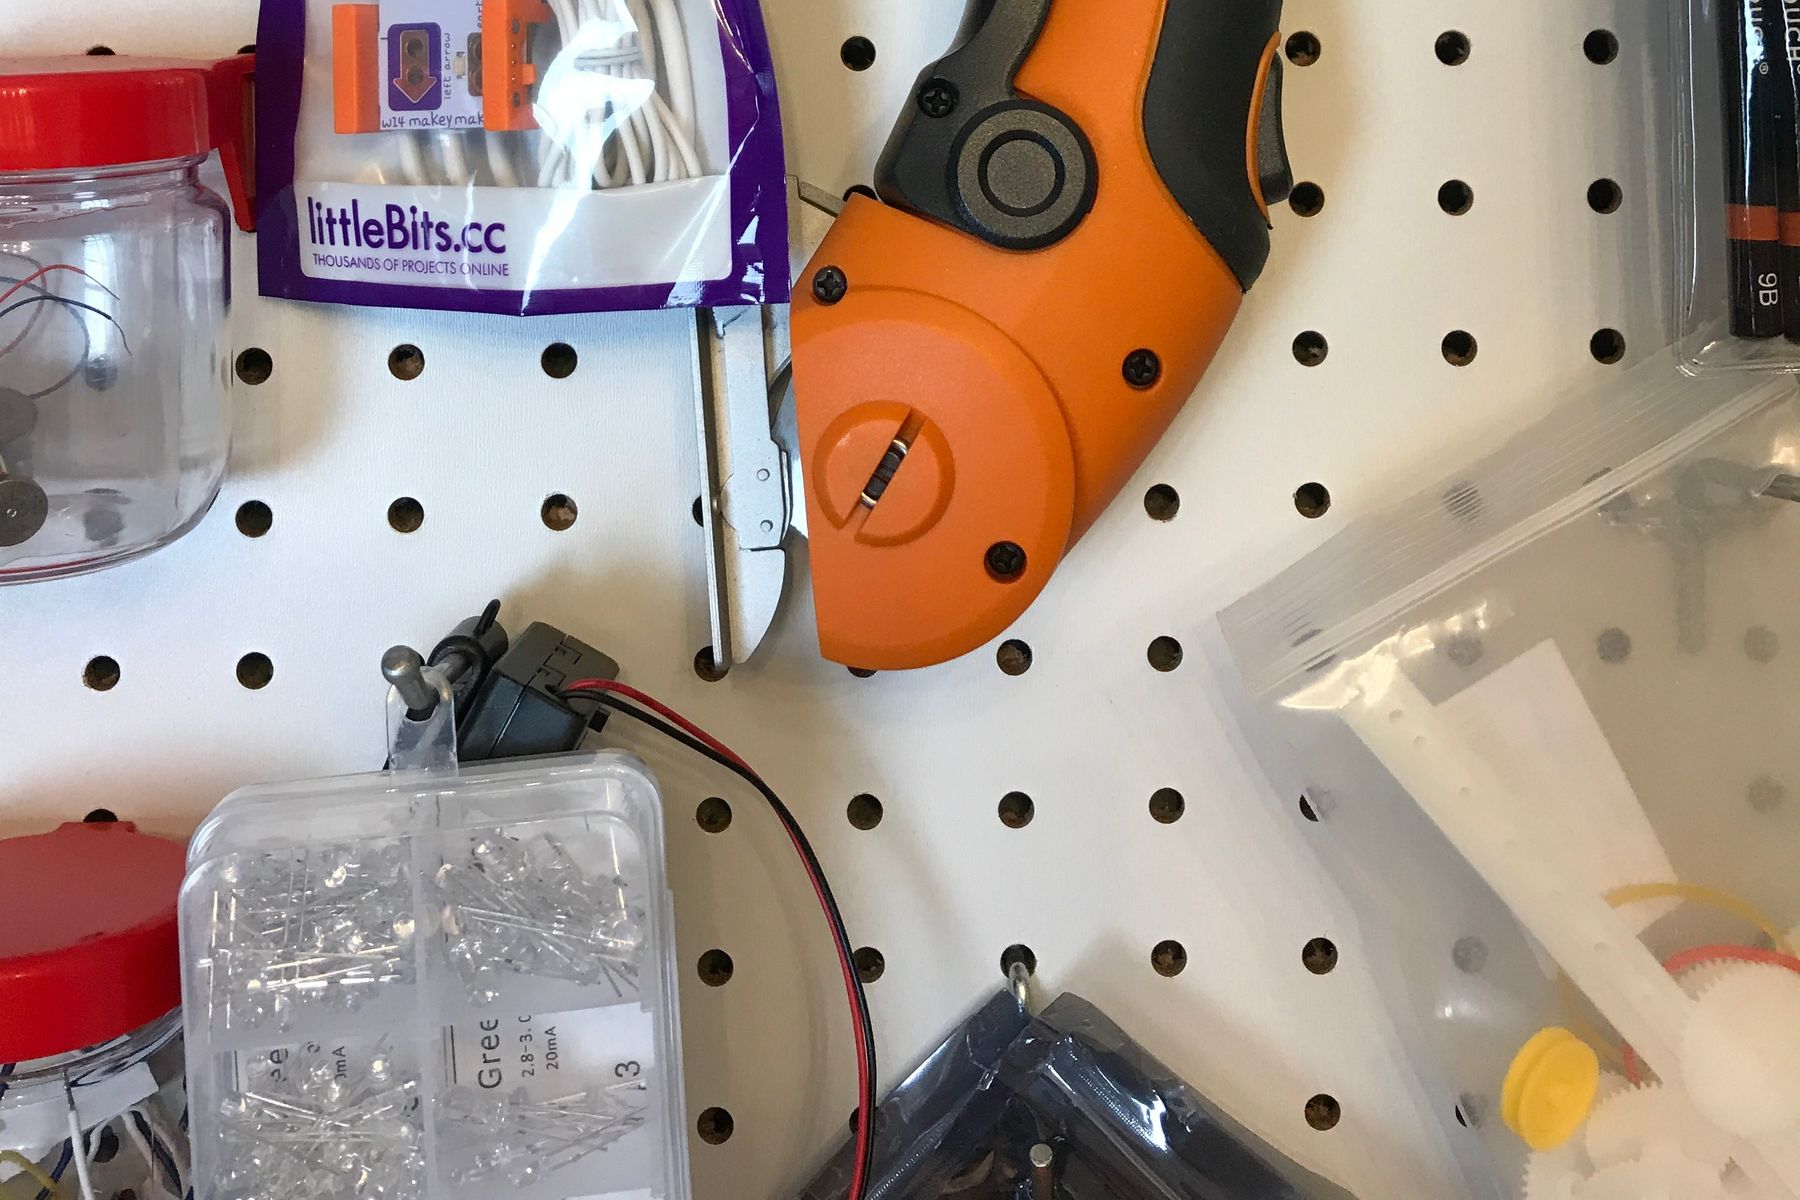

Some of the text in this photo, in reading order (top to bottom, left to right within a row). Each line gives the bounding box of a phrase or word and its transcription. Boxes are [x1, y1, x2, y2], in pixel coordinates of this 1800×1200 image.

[444, 33, 452, 100] left arrow
[382, 117, 406, 128] w14
[409, 112, 452, 128] makey
[307, 196, 507, 254] littleBits.cc
[313, 253, 510, 277] THOUSANDS OF PROJECTS ONLINE
[1758, 272, 1779, 306] 9B
[545, 1026, 559, 1070] 20mA
